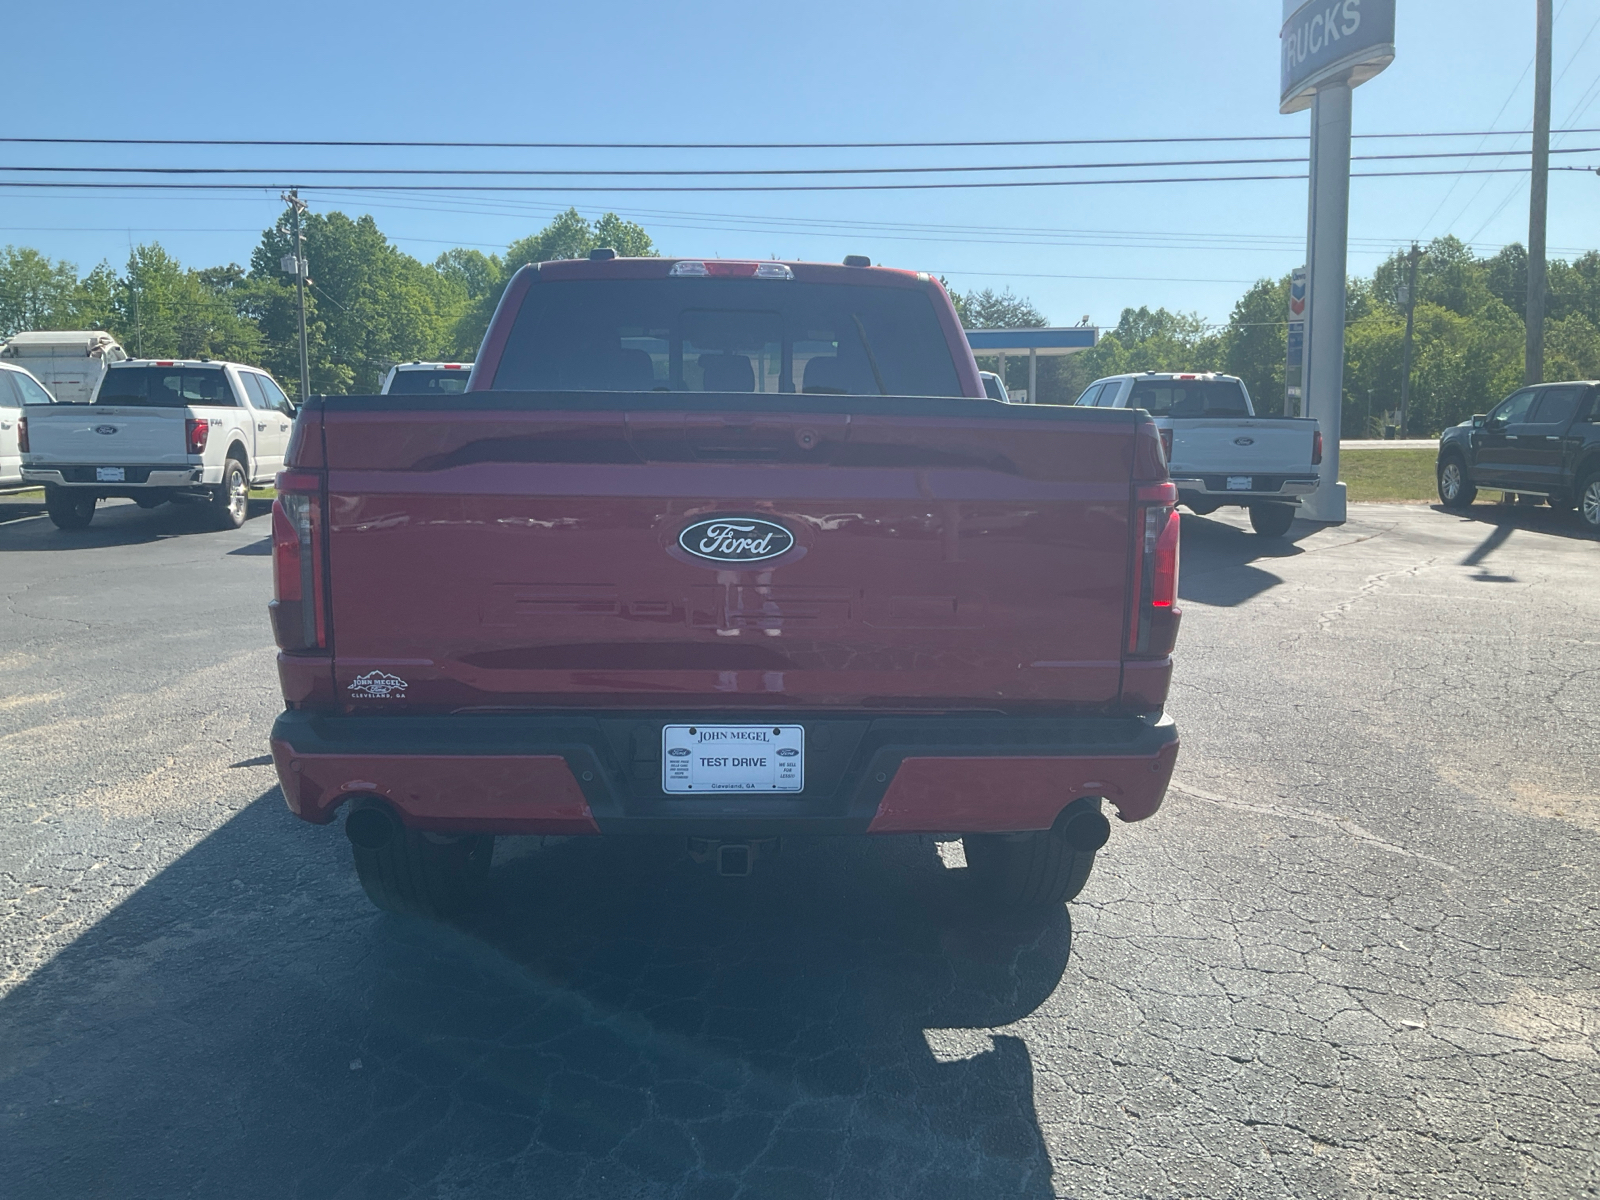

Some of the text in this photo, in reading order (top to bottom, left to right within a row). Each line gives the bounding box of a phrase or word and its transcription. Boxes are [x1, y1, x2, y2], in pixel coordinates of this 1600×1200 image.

[699, 523, 774, 554] Ford
[353, 679, 373, 687] JOHN
[698, 731, 770, 743] JOHN MEGEL
[700, 757, 767, 767] TEST DRIVE
